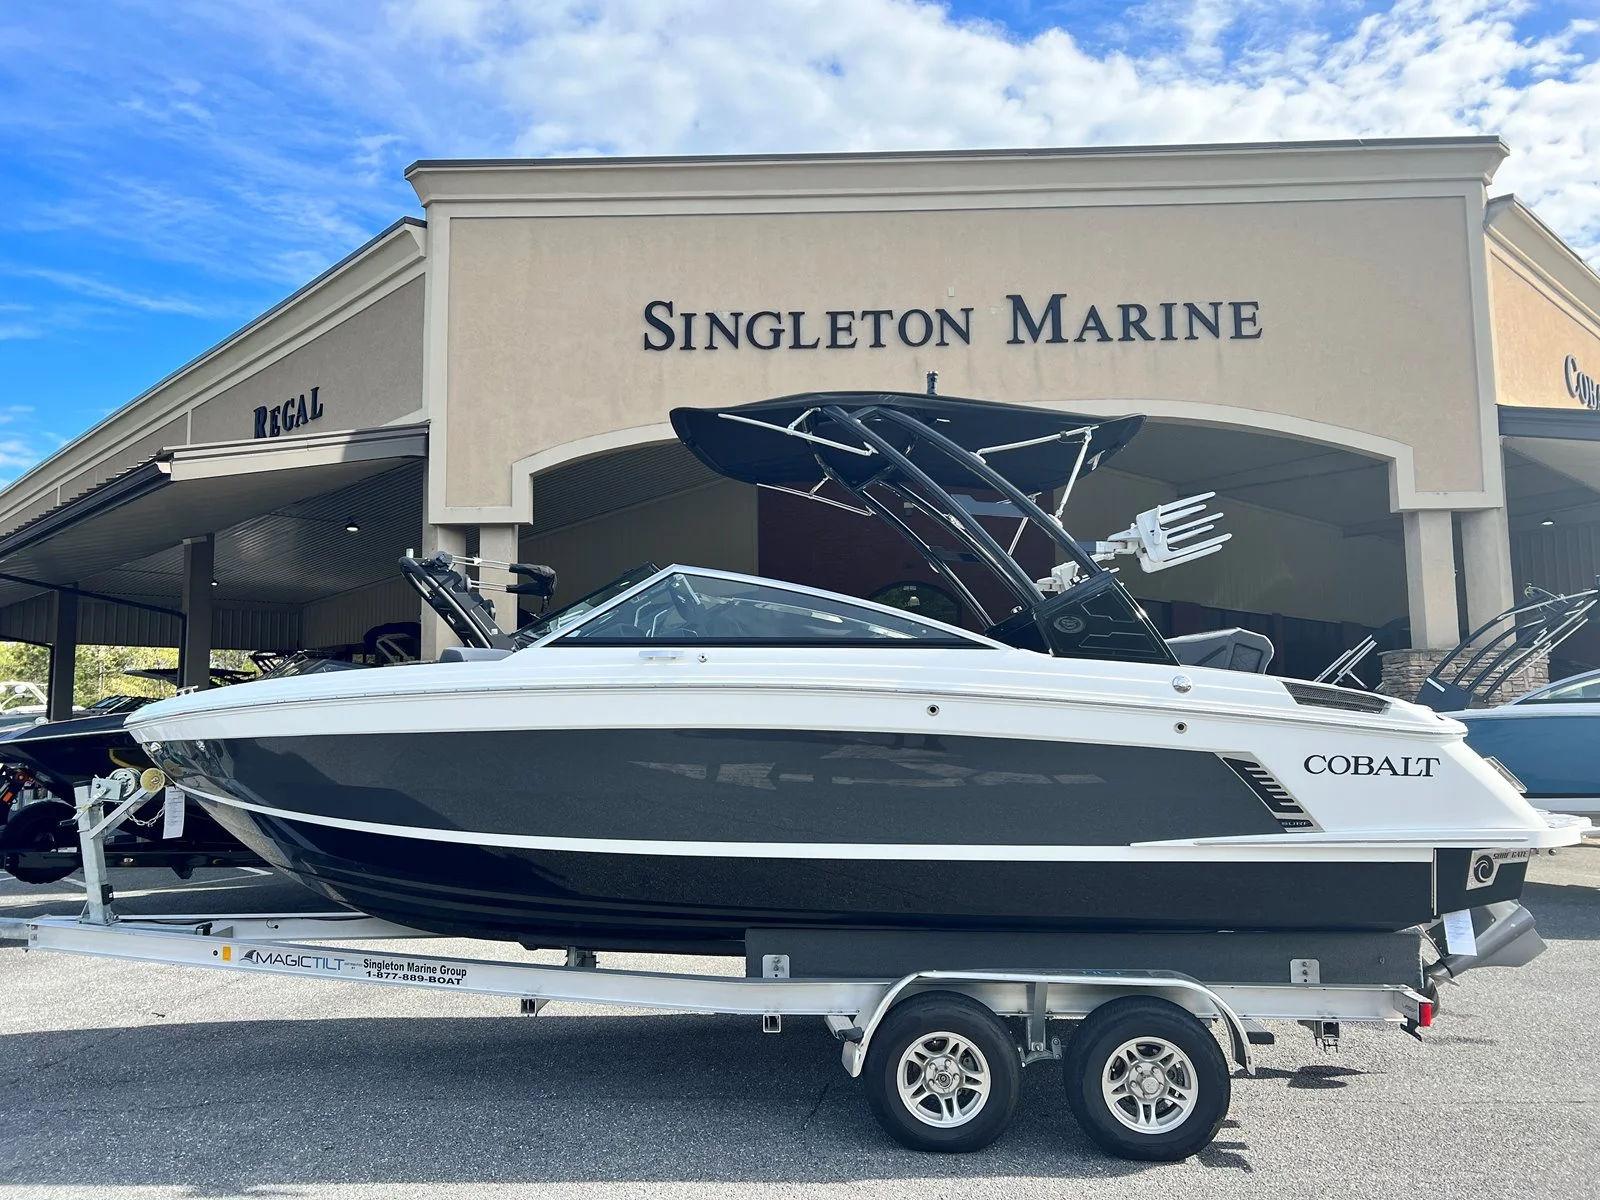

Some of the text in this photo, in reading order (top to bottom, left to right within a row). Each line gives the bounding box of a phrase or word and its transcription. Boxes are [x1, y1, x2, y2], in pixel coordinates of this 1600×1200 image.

[643, 293, 1264, 351] SINGLETON MARINE
[253, 386, 324, 439] REGAL
[1303, 754, 1441, 778] COBALT
[255, 951, 345, 971] MAGICTILT
[363, 958, 467, 978] Singleton Marine Group
[365, 970, 463, 986] 1-877-889-BOAT
